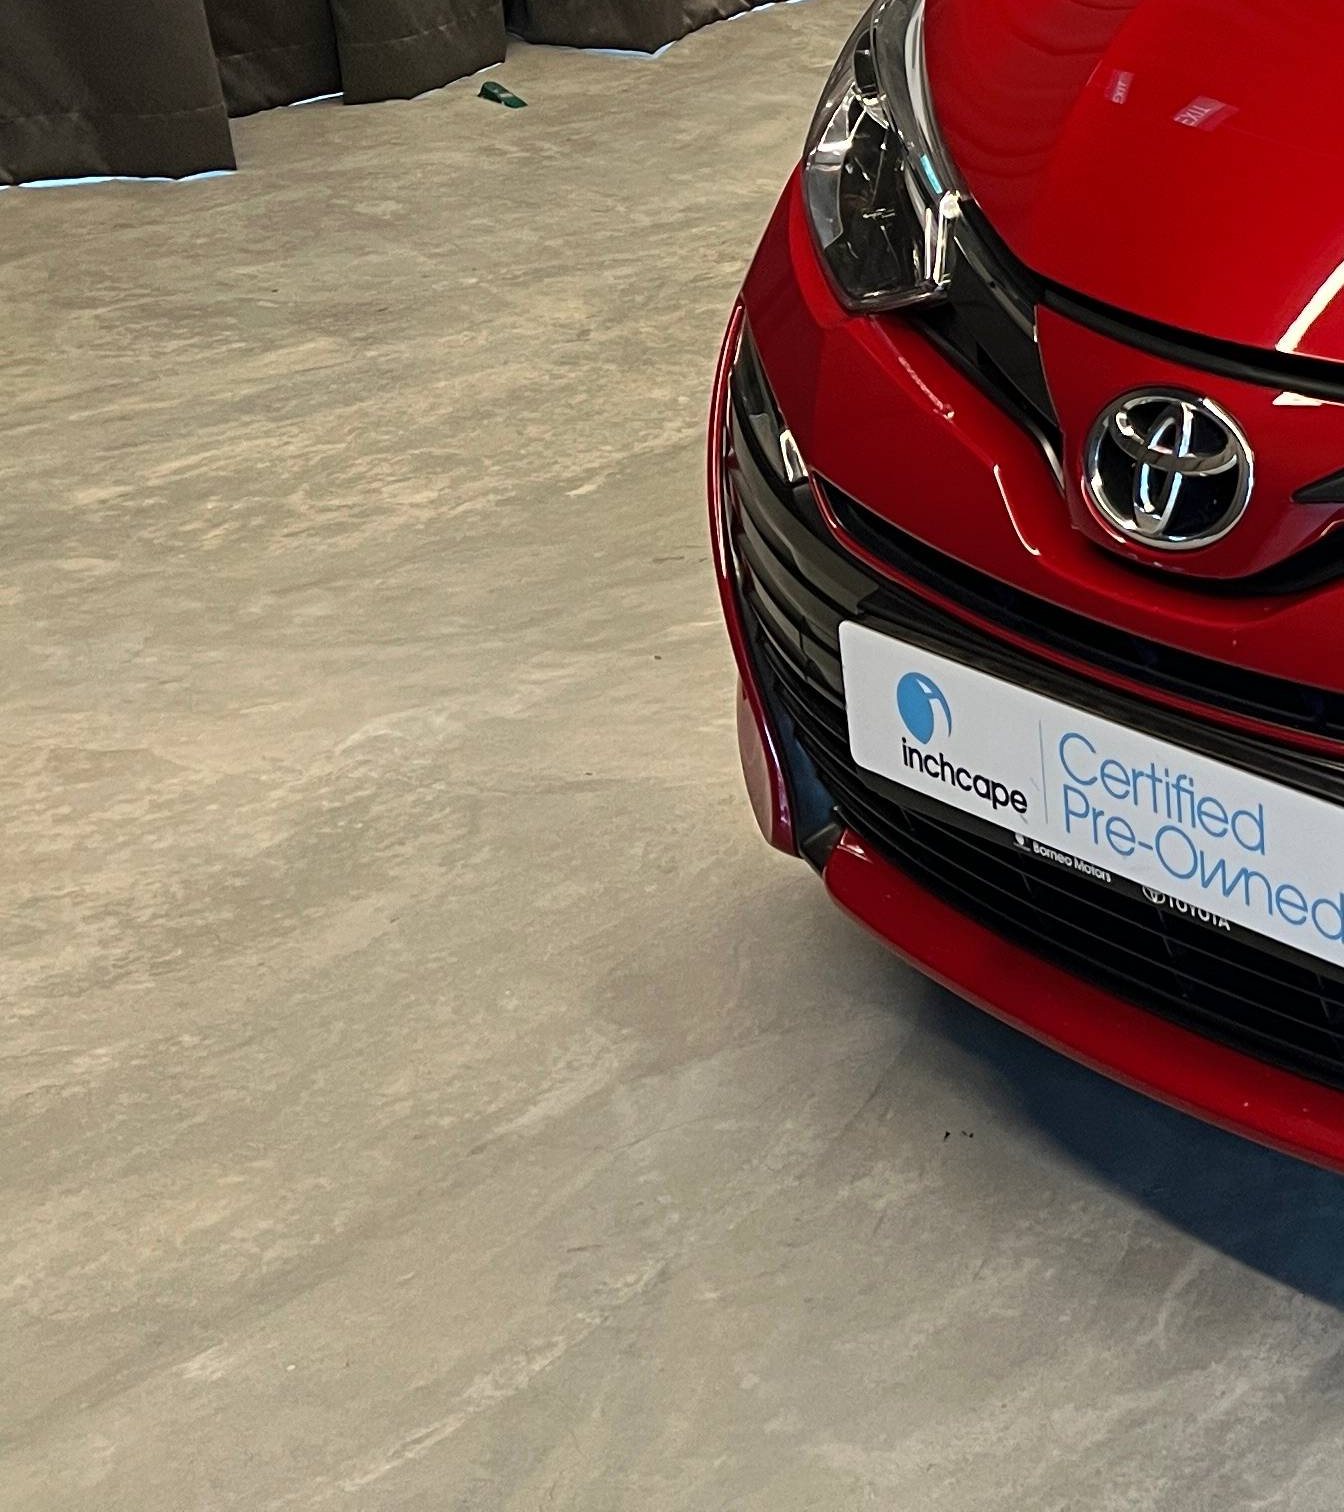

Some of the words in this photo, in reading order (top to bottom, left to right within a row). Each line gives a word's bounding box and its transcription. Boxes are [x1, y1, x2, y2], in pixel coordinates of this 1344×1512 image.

[901, 737, 1028, 815] inchcape
[1058, 731, 1266, 855] Certified
[1032, 840, 1073, 867] Borneo
[1074, 856, 1112, 884] Motors
